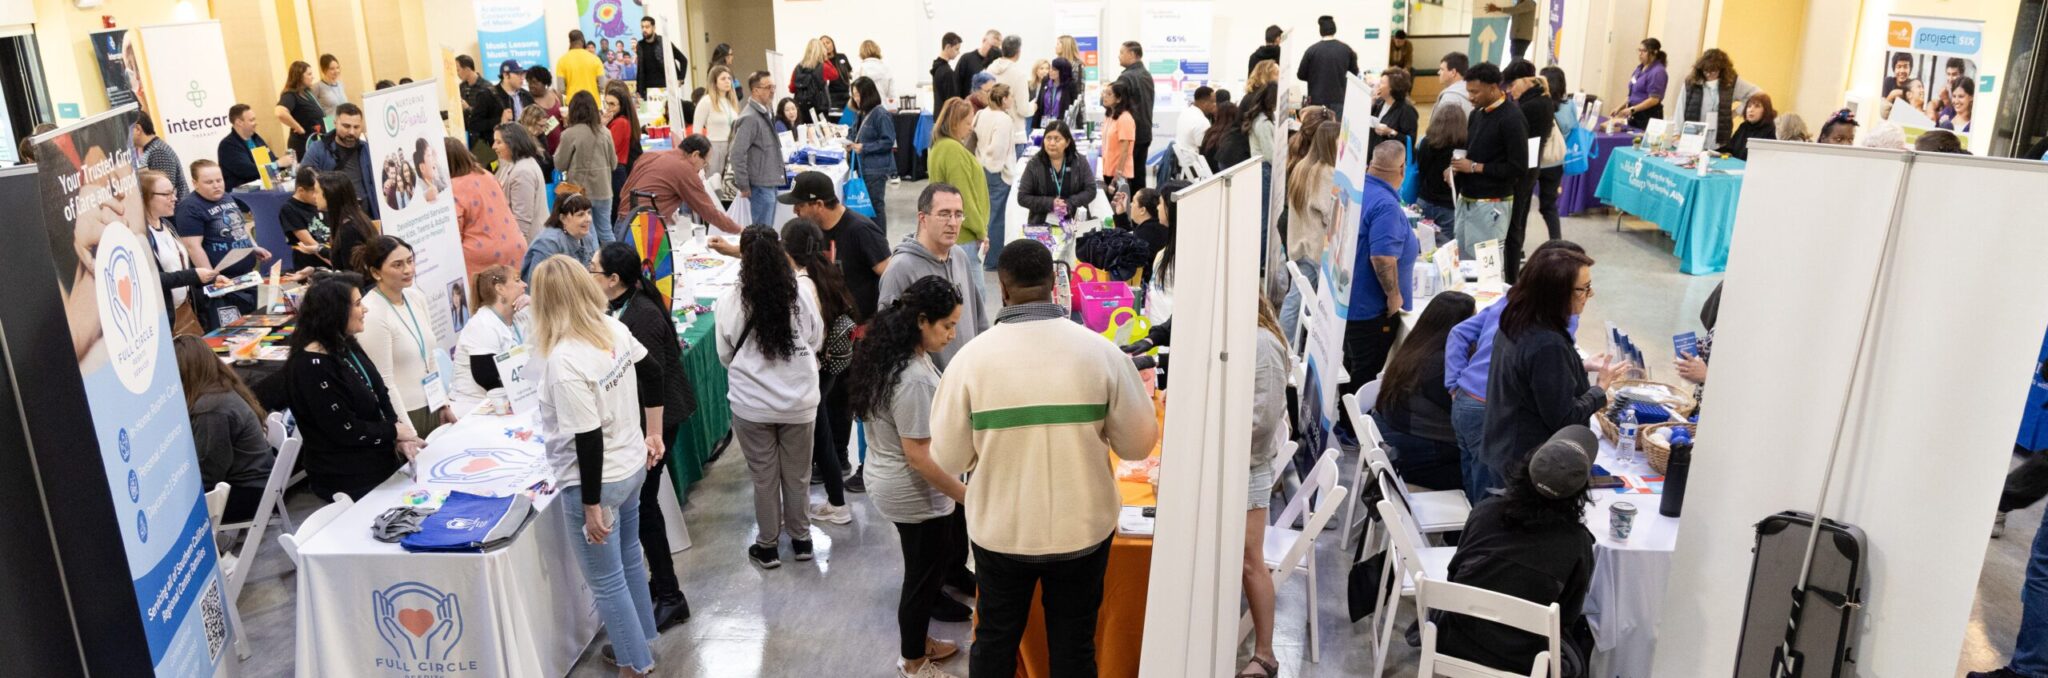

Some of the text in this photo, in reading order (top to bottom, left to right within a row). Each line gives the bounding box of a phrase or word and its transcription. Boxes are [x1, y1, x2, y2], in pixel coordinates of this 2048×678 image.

[485, 41, 539, 50] Music Lessons
[1920, 33, 1956, 46] project
[166, 115, 228, 134] intercar
[58, 148, 132, 194] Your Trusted Circl
[64, 197, 77, 221] of
[75, 194, 98, 214] Care
[1483, 255, 1494, 269] 34
[376, 658, 478, 672] FULL CIRCLE
